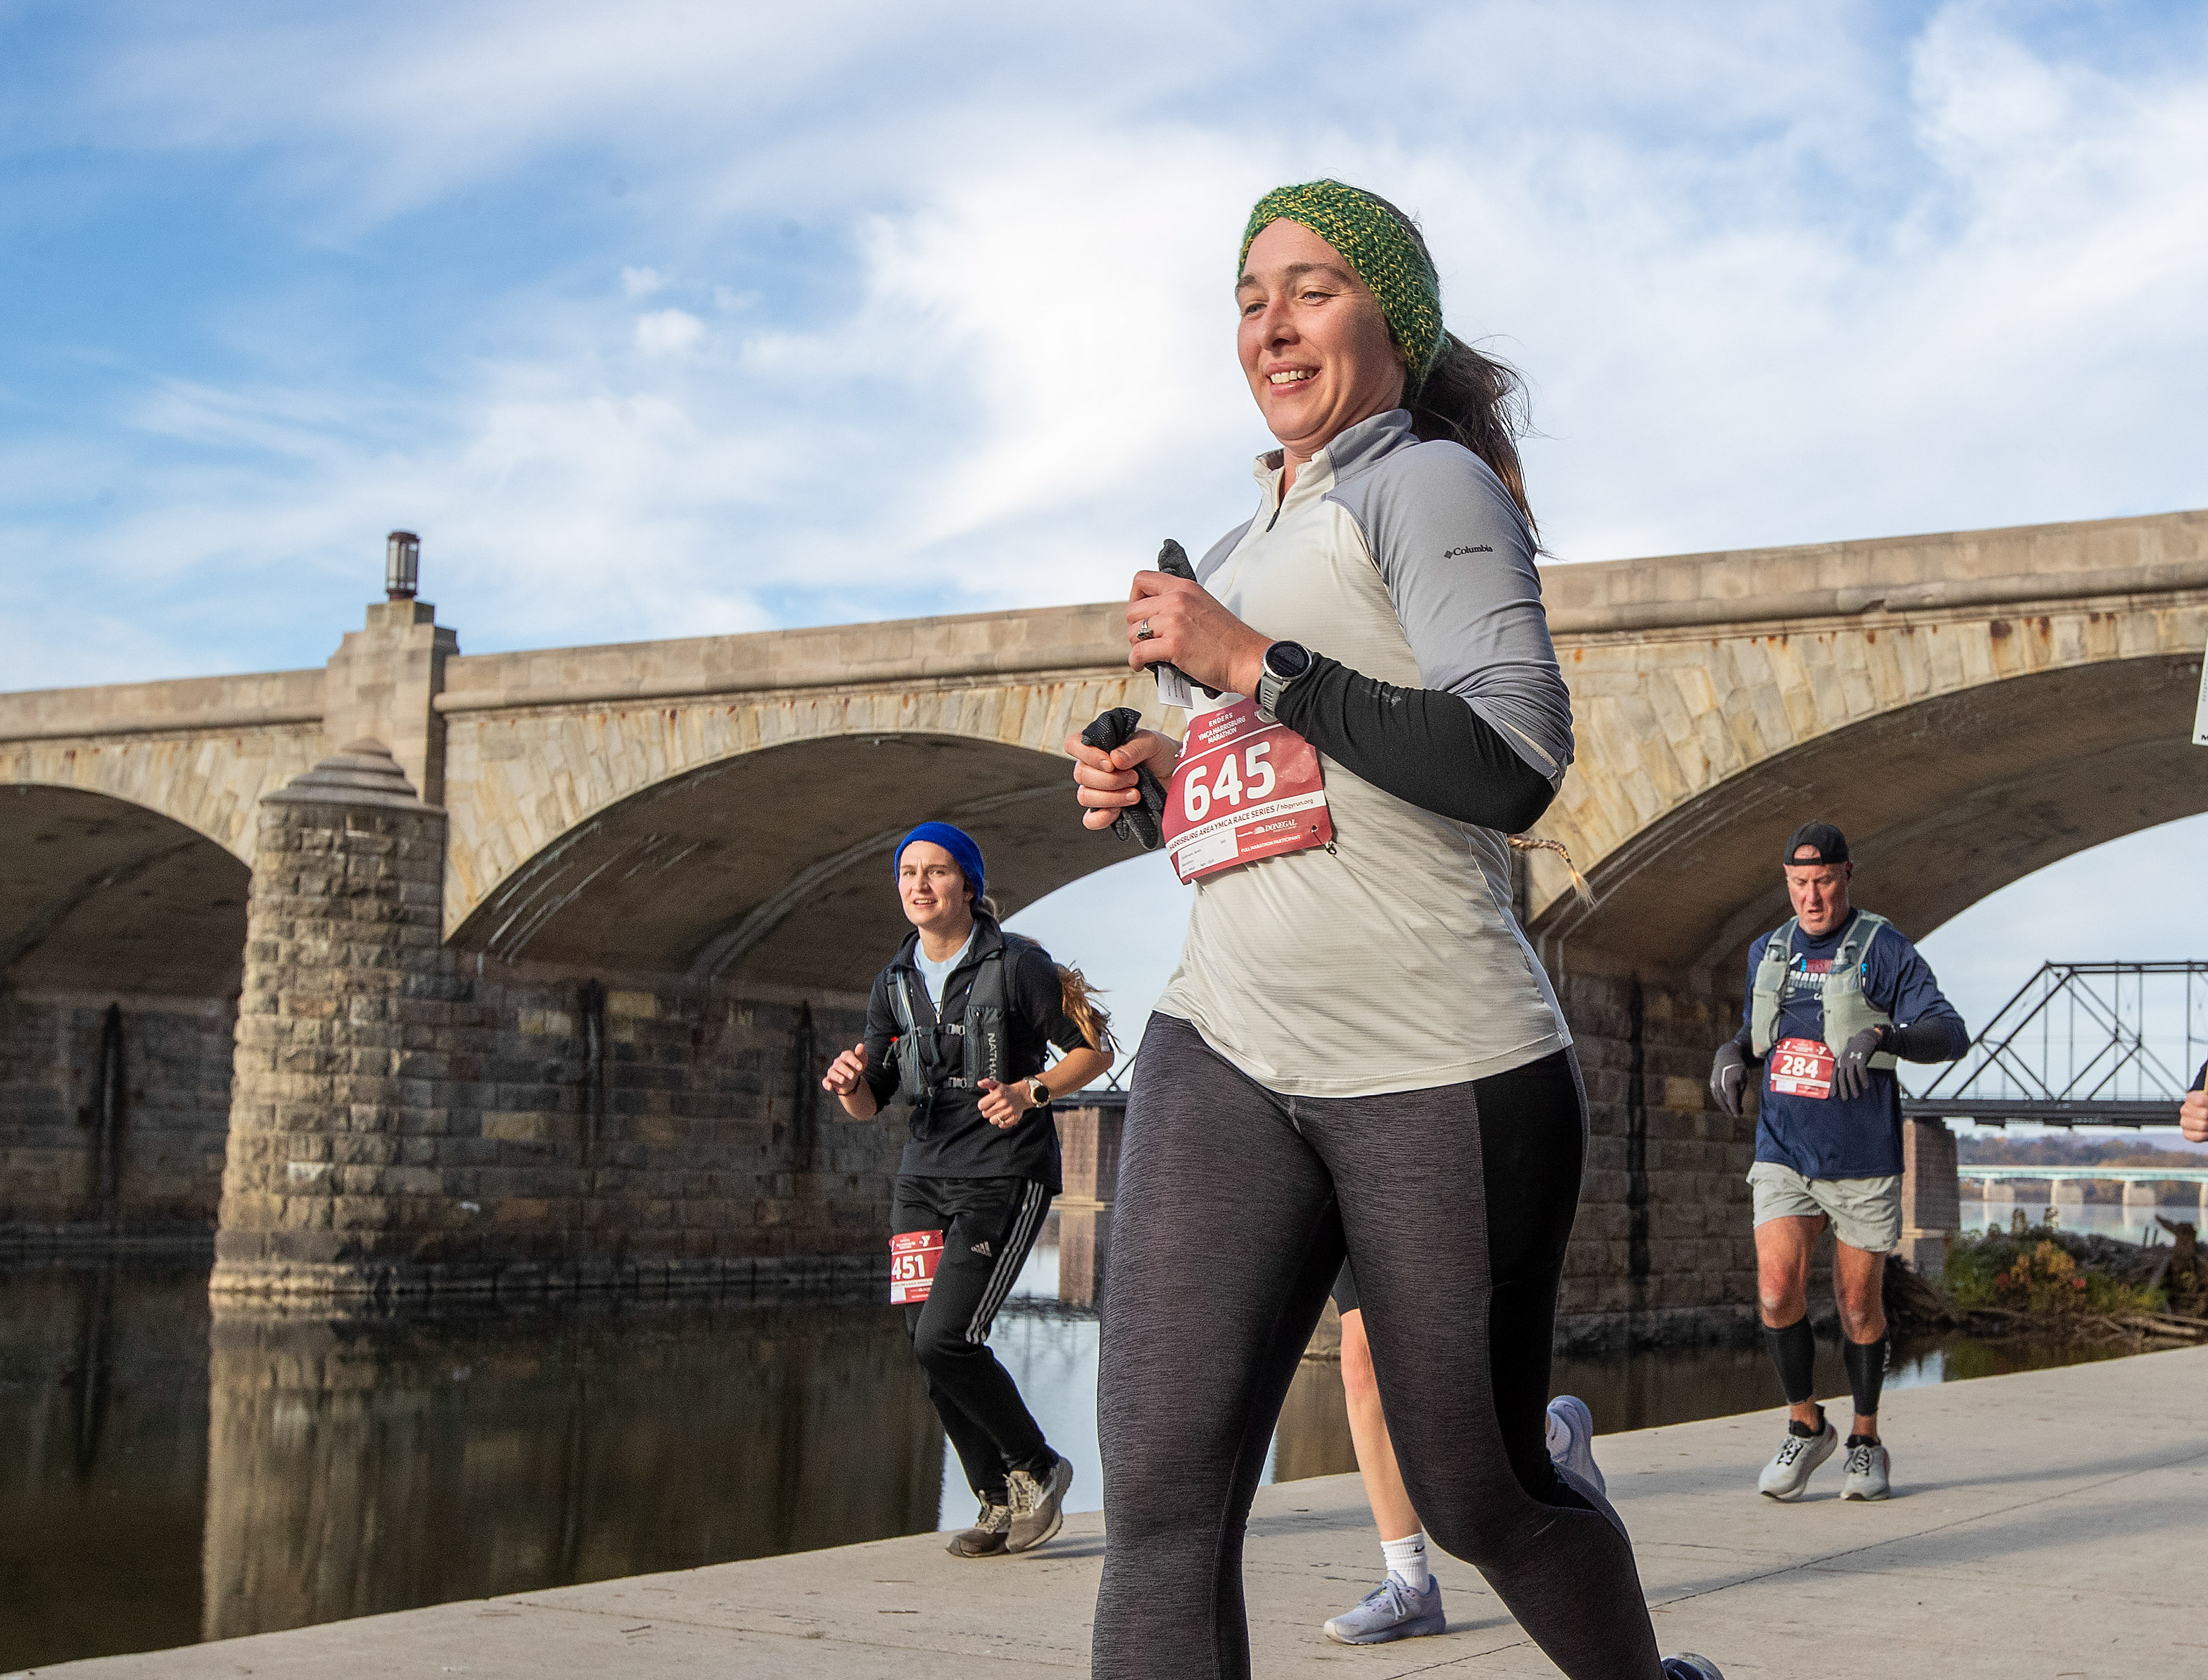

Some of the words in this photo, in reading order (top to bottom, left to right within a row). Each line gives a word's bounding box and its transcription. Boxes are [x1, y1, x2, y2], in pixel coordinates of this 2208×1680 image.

[1454, 544, 1493, 556] Columbia
[1198, 730, 1213, 741] YMCA
[1213, 716, 1246, 735] HARRISBURG
[1208, 712, 1233, 727] ENDERS
[1208, 726, 1237, 744] MARATHON
[1184, 741, 1276, 822] 645
[1199, 826, 1214, 836] AREA
[1214, 819, 1232, 829] YMCA
[1233, 813, 1250, 823] RACE
[1251, 806, 1275, 818] SERIES
[1265, 819, 1296, 832] DONEGAL
[1780, 1055, 1819, 1079] 284
[892, 1254, 925, 1280] 451
